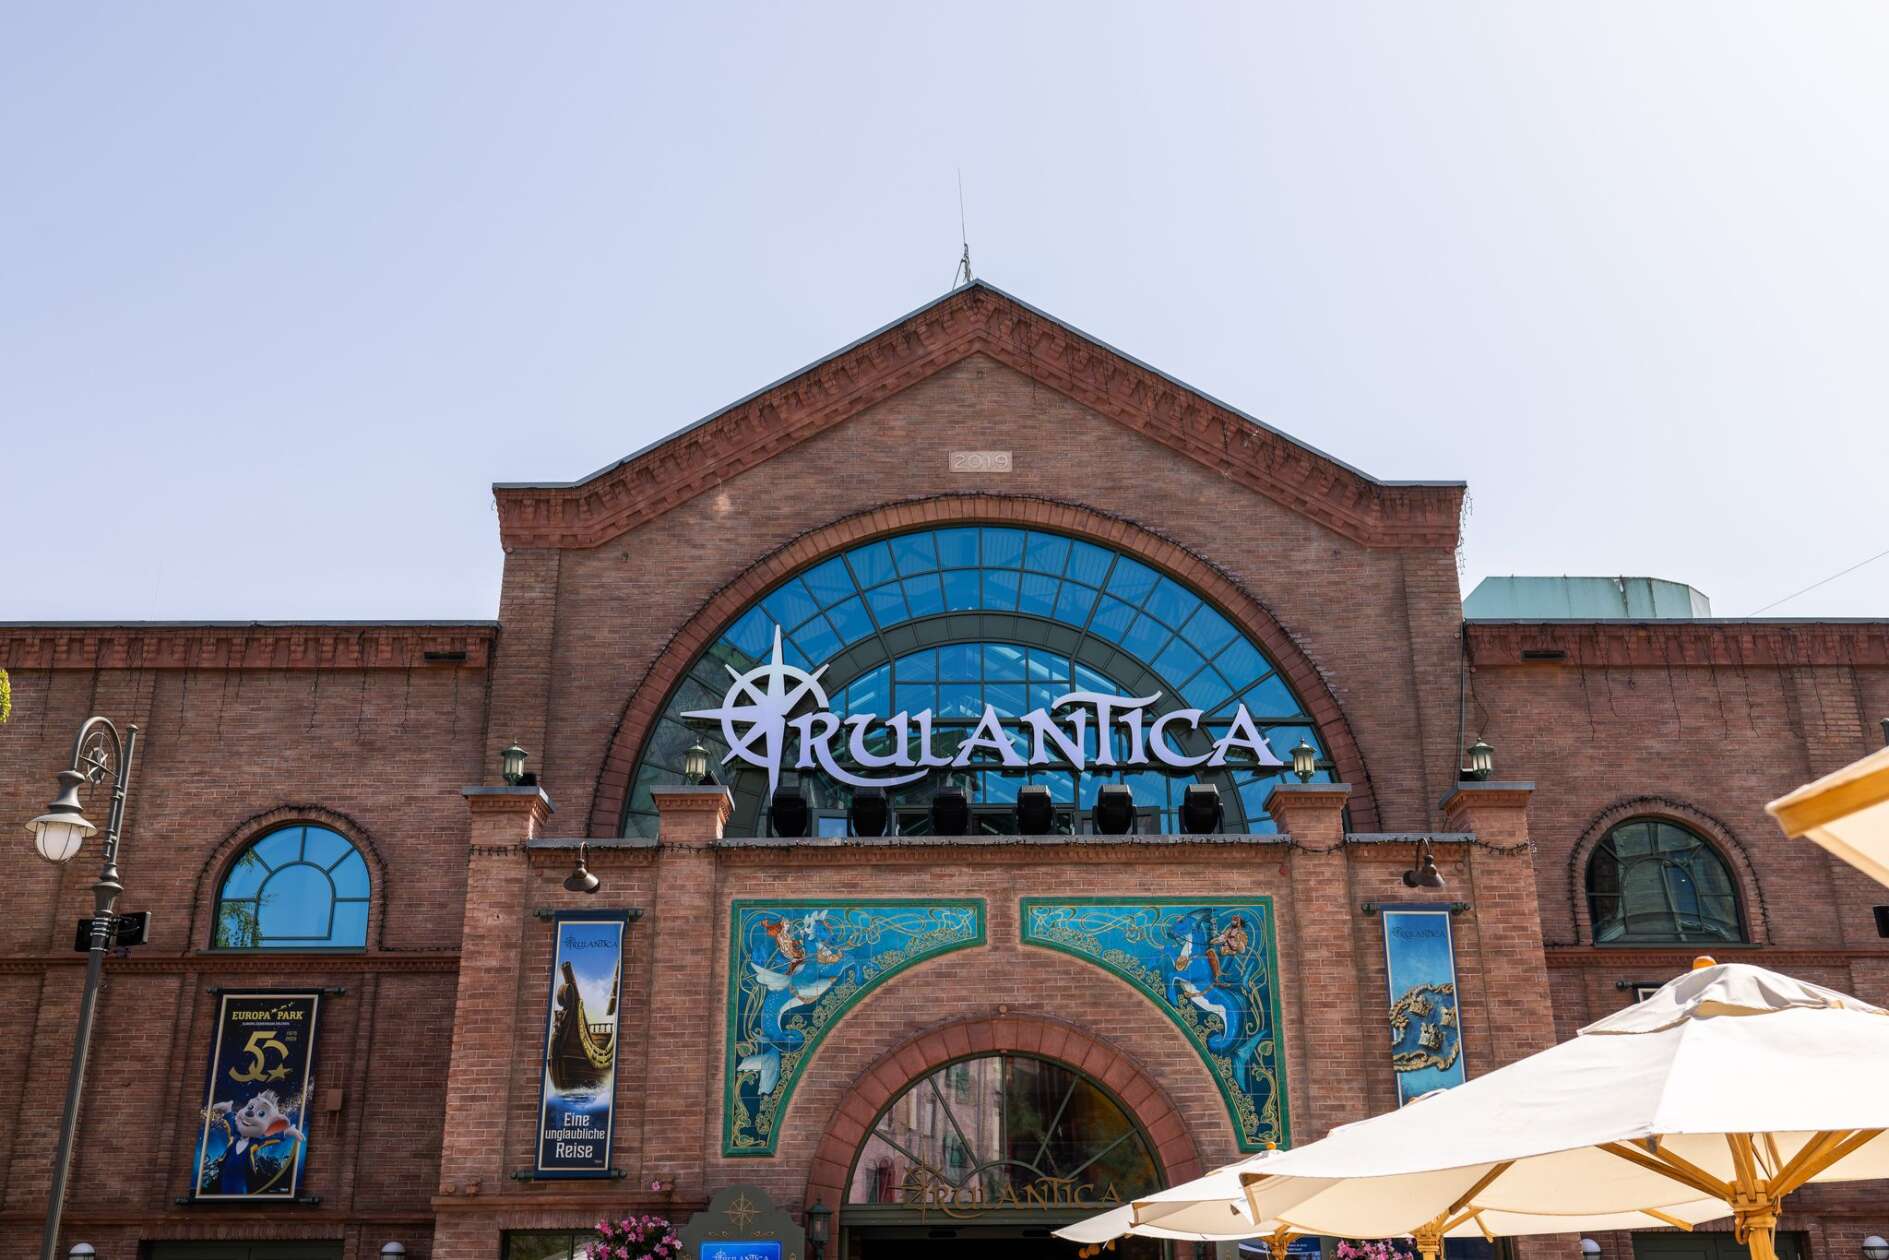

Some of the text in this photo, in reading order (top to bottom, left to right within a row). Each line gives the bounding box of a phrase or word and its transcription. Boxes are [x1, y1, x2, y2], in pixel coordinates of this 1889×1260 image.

[954, 454, 1009, 469] 2019
[787, 690, 1284, 787] RULANTICA
[232, 1011, 304, 1020] EUROPA PARK
[564, 1112, 590, 1127] Eine
[545, 1128, 605, 1141] unglaubliche
[555, 1142, 593, 1158] Reise
[928, 1176, 1121, 1219] RULANTICA
